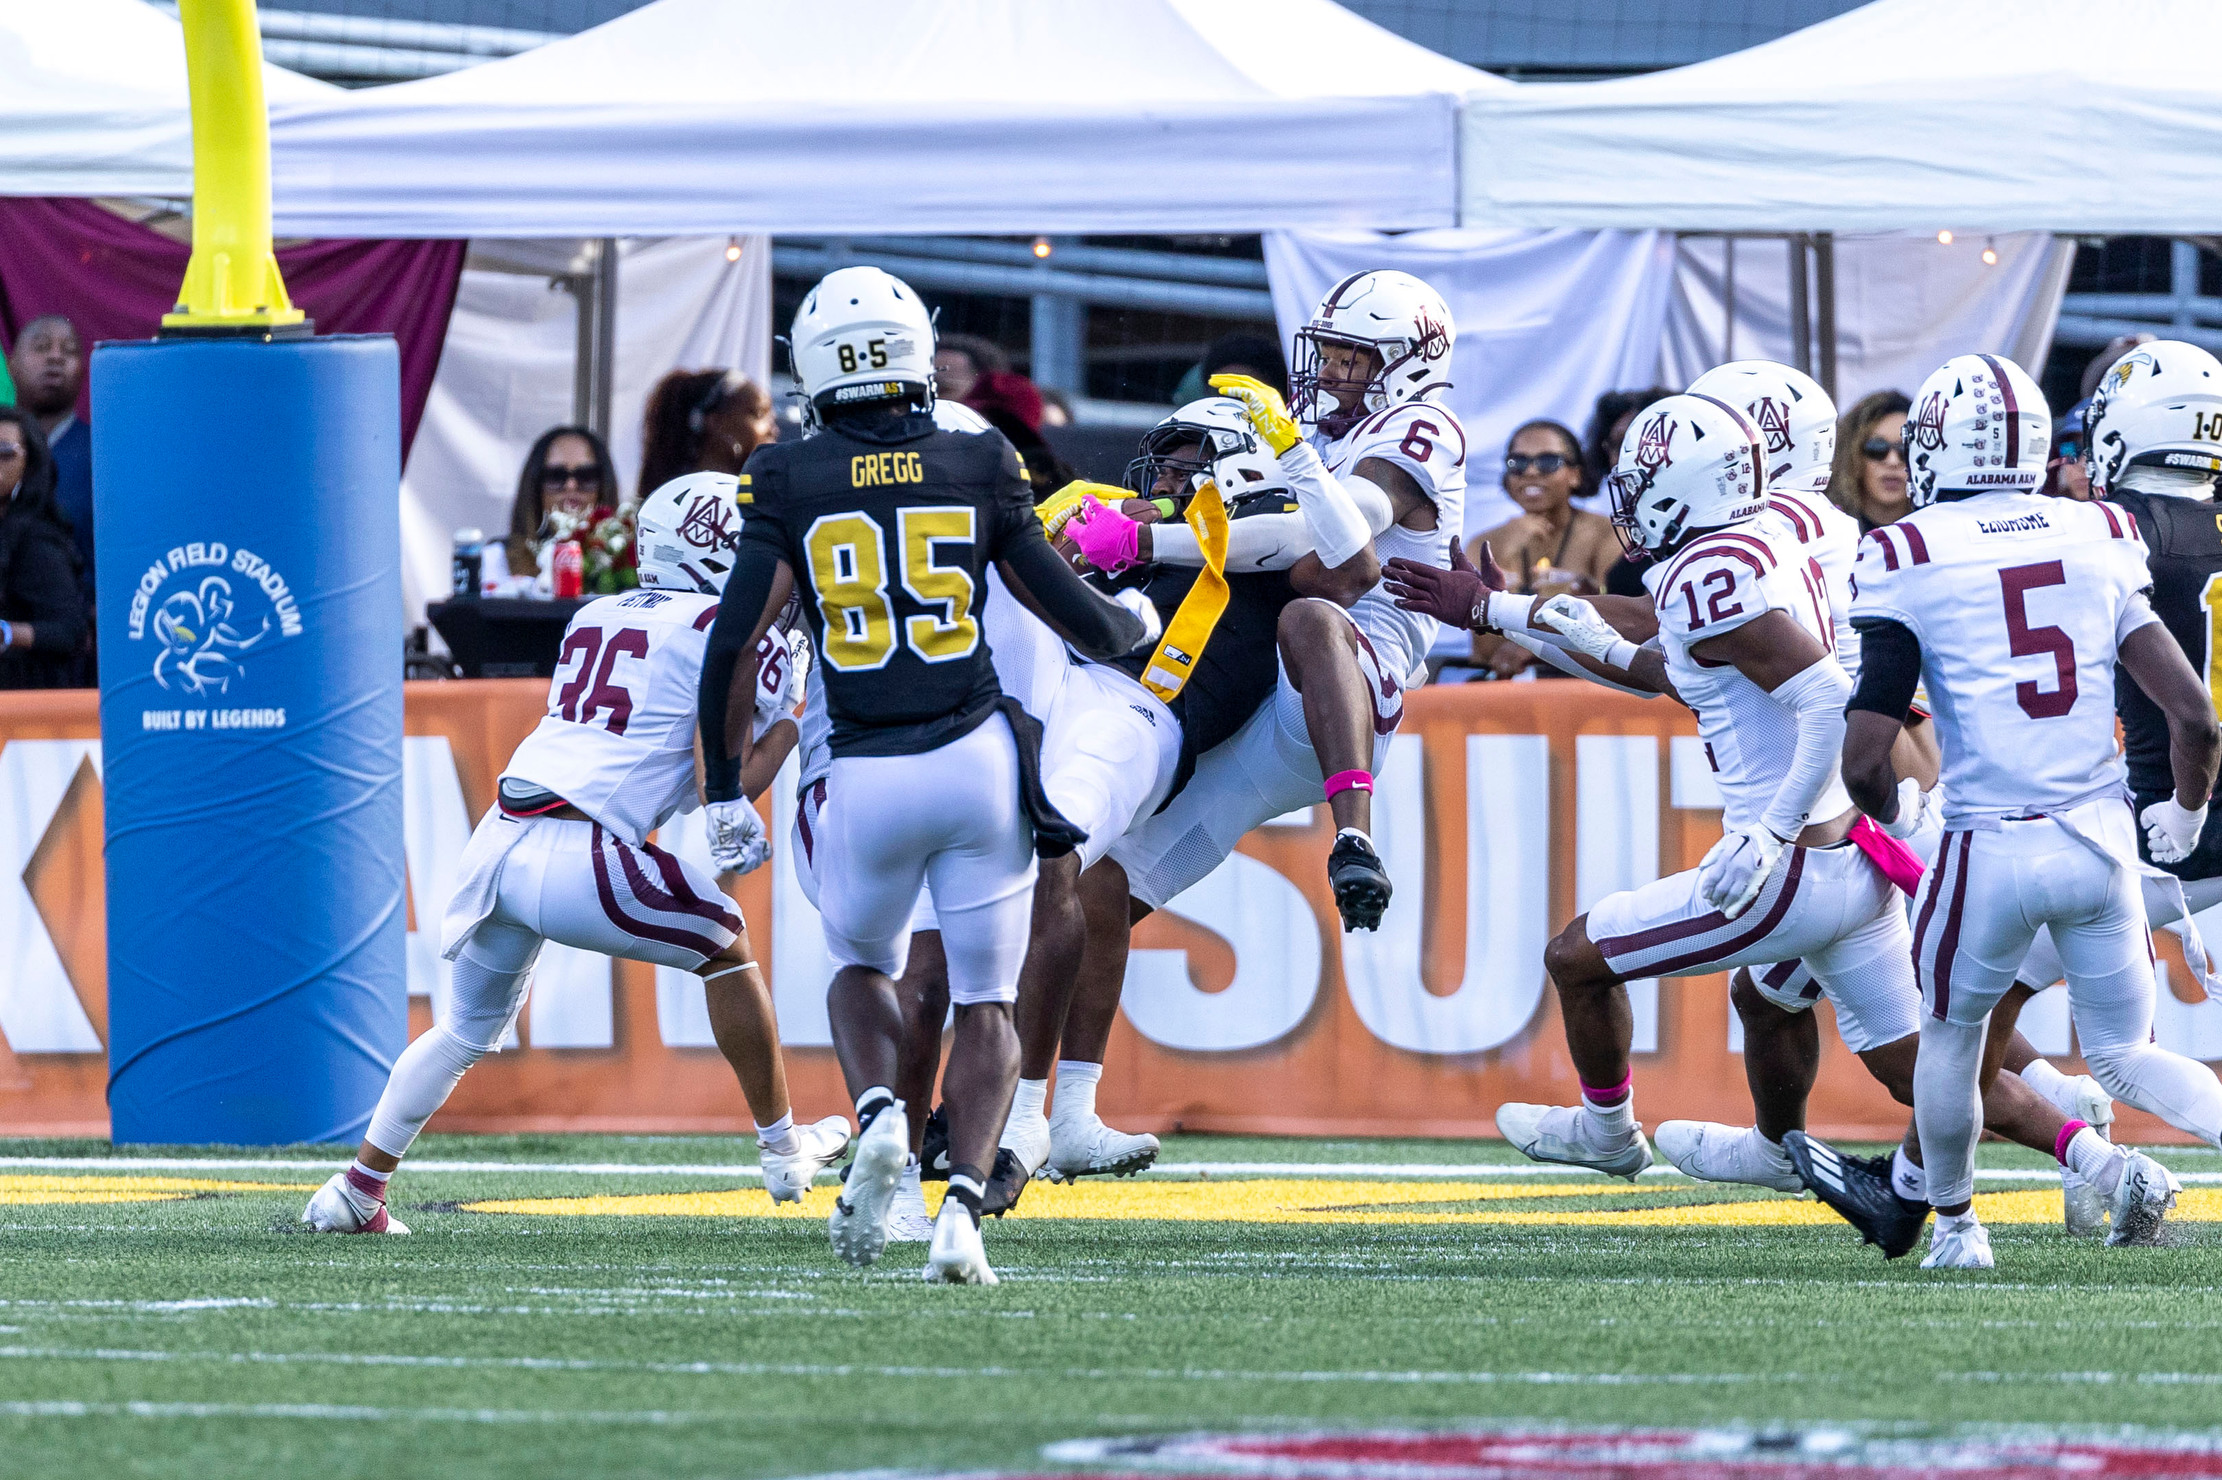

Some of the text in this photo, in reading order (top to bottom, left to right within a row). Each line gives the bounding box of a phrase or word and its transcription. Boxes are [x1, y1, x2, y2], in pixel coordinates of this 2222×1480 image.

[851, 451, 924, 489] GREGG
[1399, 419, 1440, 463] 6
[1966, 474, 2037, 486] ALABAMA A&M
[128, 542, 303, 640] LEGION FIELD STADIUM
[803, 505, 980, 673] 85
[1680, 568, 1744, 631] 12
[1998, 560, 2078, 719] 5
[557, 627, 649, 736] 36
[142, 707, 287, 731] BUILT BY LEGENDS
